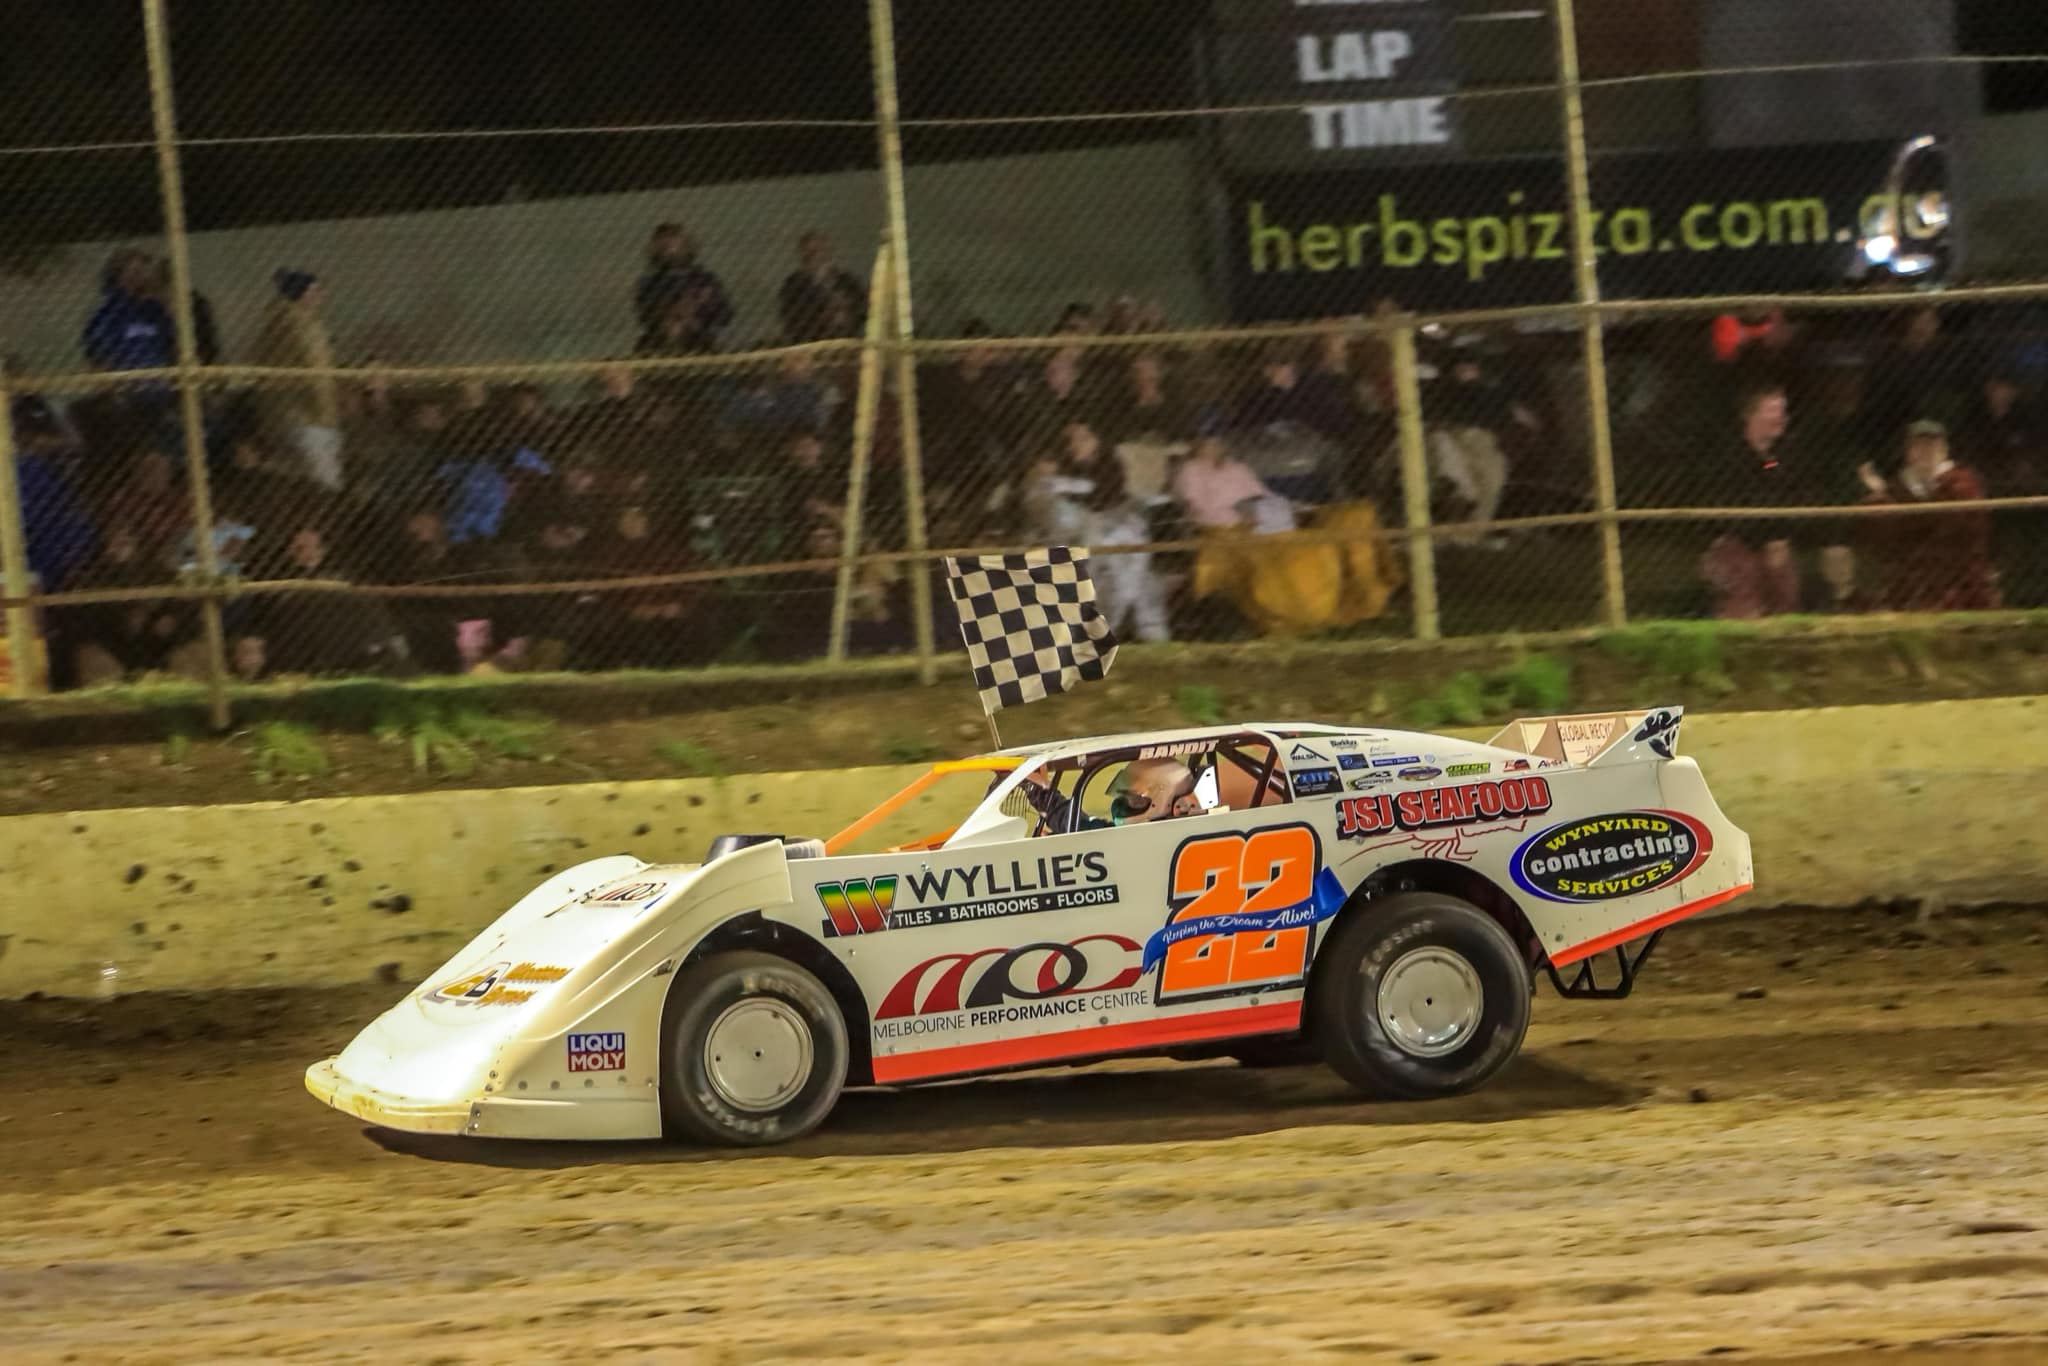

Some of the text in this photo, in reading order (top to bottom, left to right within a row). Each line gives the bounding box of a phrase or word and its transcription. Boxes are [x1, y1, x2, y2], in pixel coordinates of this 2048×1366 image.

[1297, 30, 1413, 82] LAP
[1303, 97, 1450, 149] TIME
[1139, 740, 1220, 760] BANDIT
[1559, 724, 1589, 742] GLOBAL
[1399, 776, 1551, 827] SEAFOOD
[1530, 833, 1690, 875] contracting
[1545, 818, 1669, 851] WYNYARD
[905, 852, 1108, 904] WYLLIE'S
[1558, 859, 1674, 895] SERVICES
[895, 887, 1115, 927] TILES BATHROOMS FLOORS
[1155, 822, 1322, 1006] 22
[1199, 918, 1215, 930] the
[1215, 915, 1263, 928] Dream
[1266, 904, 1315, 929] Alive!
[874, 989, 1149, 1040] MELBOURNE PERFORMANCE CENTRE
[570, 1034, 623, 1052] LIQUI
[570, 1052, 624, 1071] MOLY
